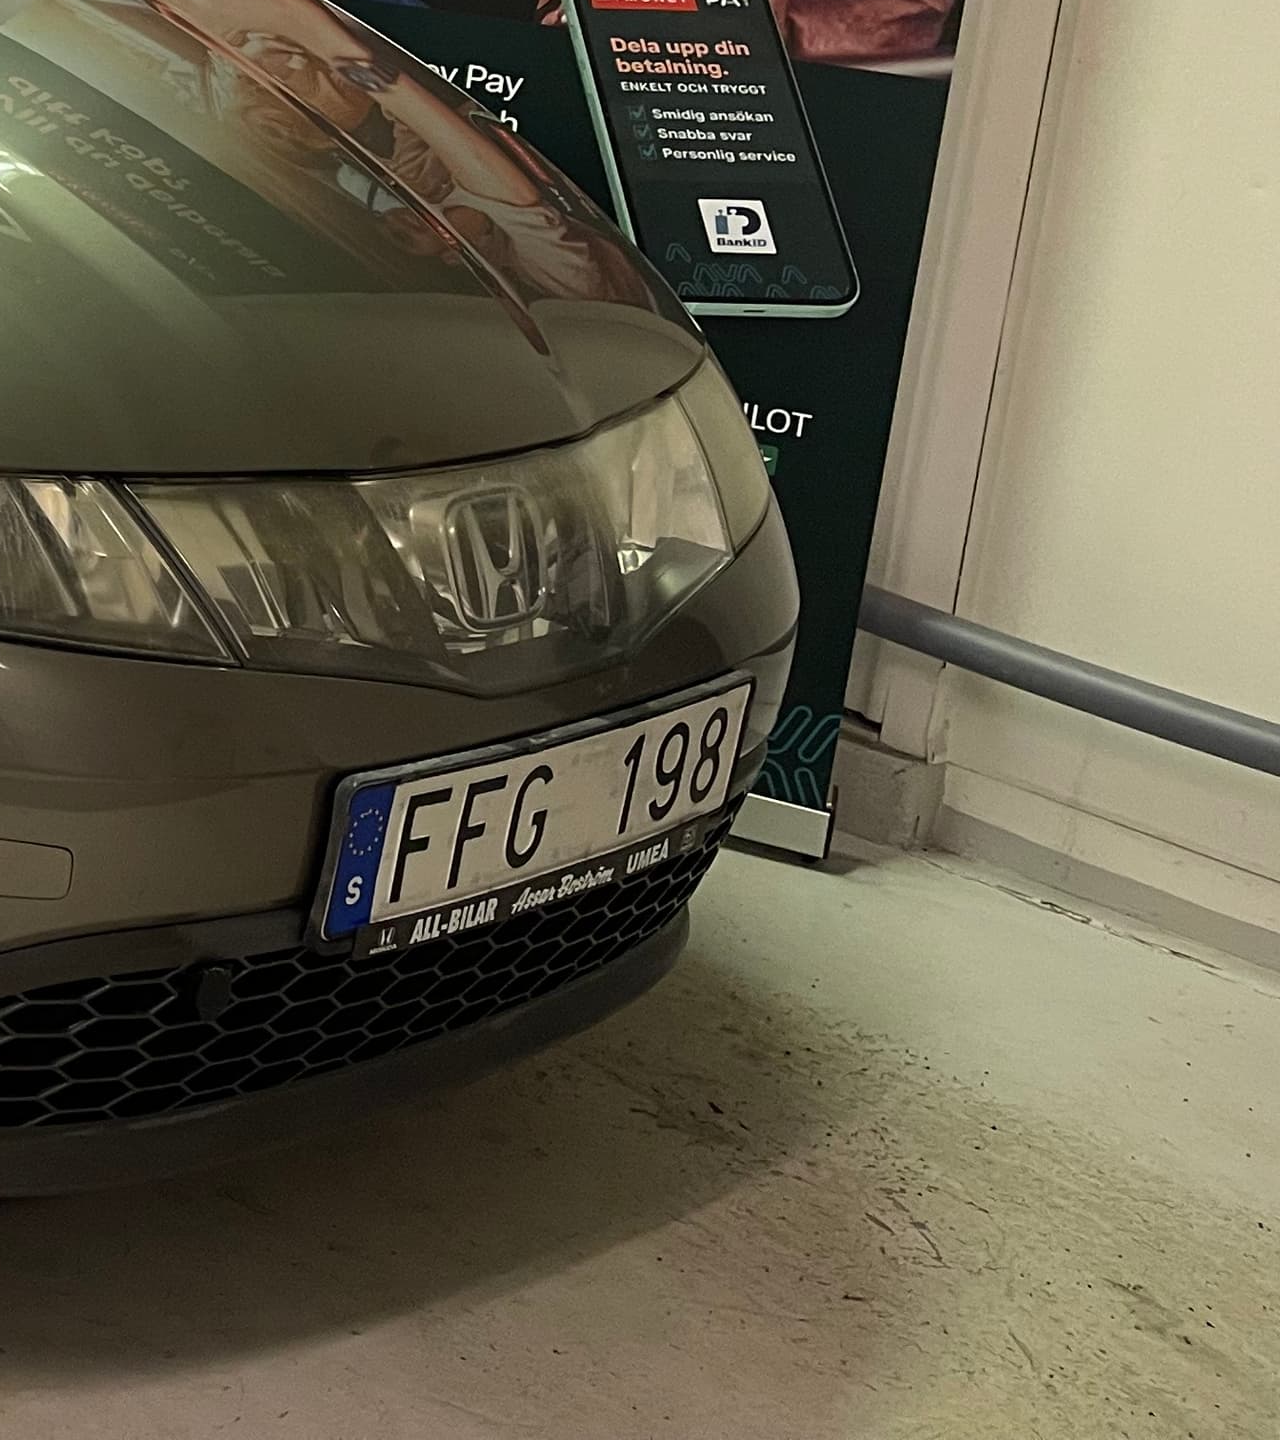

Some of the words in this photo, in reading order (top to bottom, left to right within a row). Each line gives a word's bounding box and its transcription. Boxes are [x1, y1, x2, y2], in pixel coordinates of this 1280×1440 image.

[610, 37, 661, 54] Dela
[666, 42, 709, 59] upp
[714, 40, 750, 56] din
[616, 59, 730, 79] betalning.
[465, 63, 525, 102] Pay
[620, 81, 673, 93] ENKELT
[677, 82, 709, 94] OCH
[712, 83, 768, 96] TRYGGT
[651, 108, 706, 123] Smidig
[709, 108, 775, 123] ansökan
[656, 128, 717, 141] Snabba
[719, 131, 753, 142] svar
[661, 148, 736, 163] Personlig
[738, 150, 797, 163] service
[716, 238, 767, 248] BankID
[388, 763, 555, 904] FFG
[617, 705, 730, 837] 198
[345, 875, 363, 905] S
[408, 897, 498, 945] ALL-BILAR
